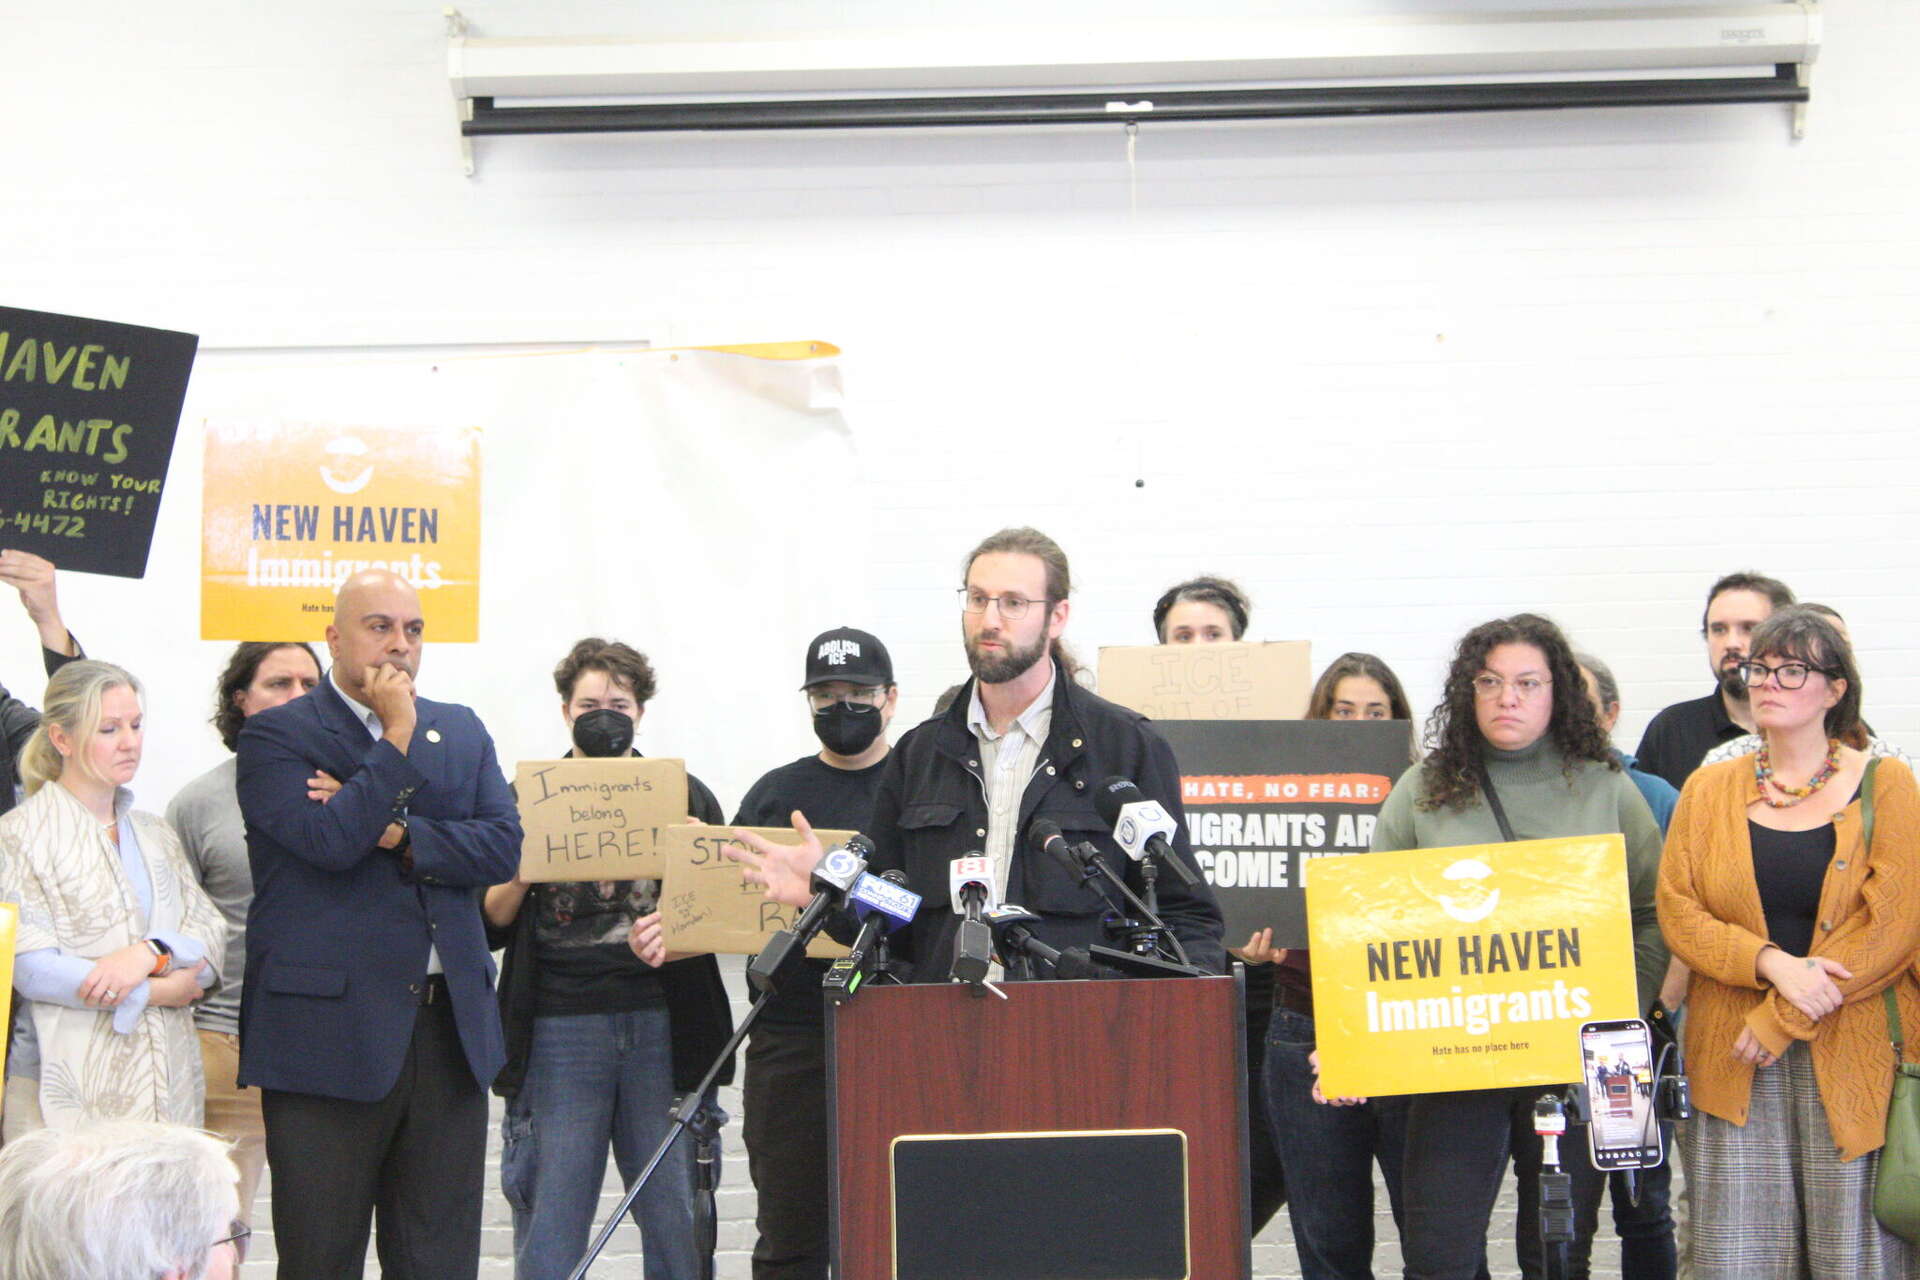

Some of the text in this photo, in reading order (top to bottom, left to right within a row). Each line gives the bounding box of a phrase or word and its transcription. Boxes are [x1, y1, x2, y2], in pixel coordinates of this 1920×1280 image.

[0, 408, 133, 464] RANTS
[40, 470, 161, 494] KNOW YOUR
[42, 489, 134, 516] RIGHTS!
[252, 503, 438, 544] NEW HAVEN
[248, 548, 442, 595] Immignts
[302, 603, 319, 613] Hate
[818, 639, 860, 660] ABOLISH
[828, 653, 847, 665] ICE
[1151, 648, 1253, 696] ICE
[532, 767, 653, 806] Immigrants
[1184, 782, 1380, 799] HATE, NO FEAR:
[569, 806, 627, 828] belong
[1185, 813, 1326, 848] IGRANTS
[546, 828, 658, 864] HERE!
[691, 837, 769, 865] STO
[1367, 928, 1581, 982] NEW HAVEN
[1366, 980, 1593, 1035] Immigrants
[1432, 1041, 1530, 1056] Hate has no place here
